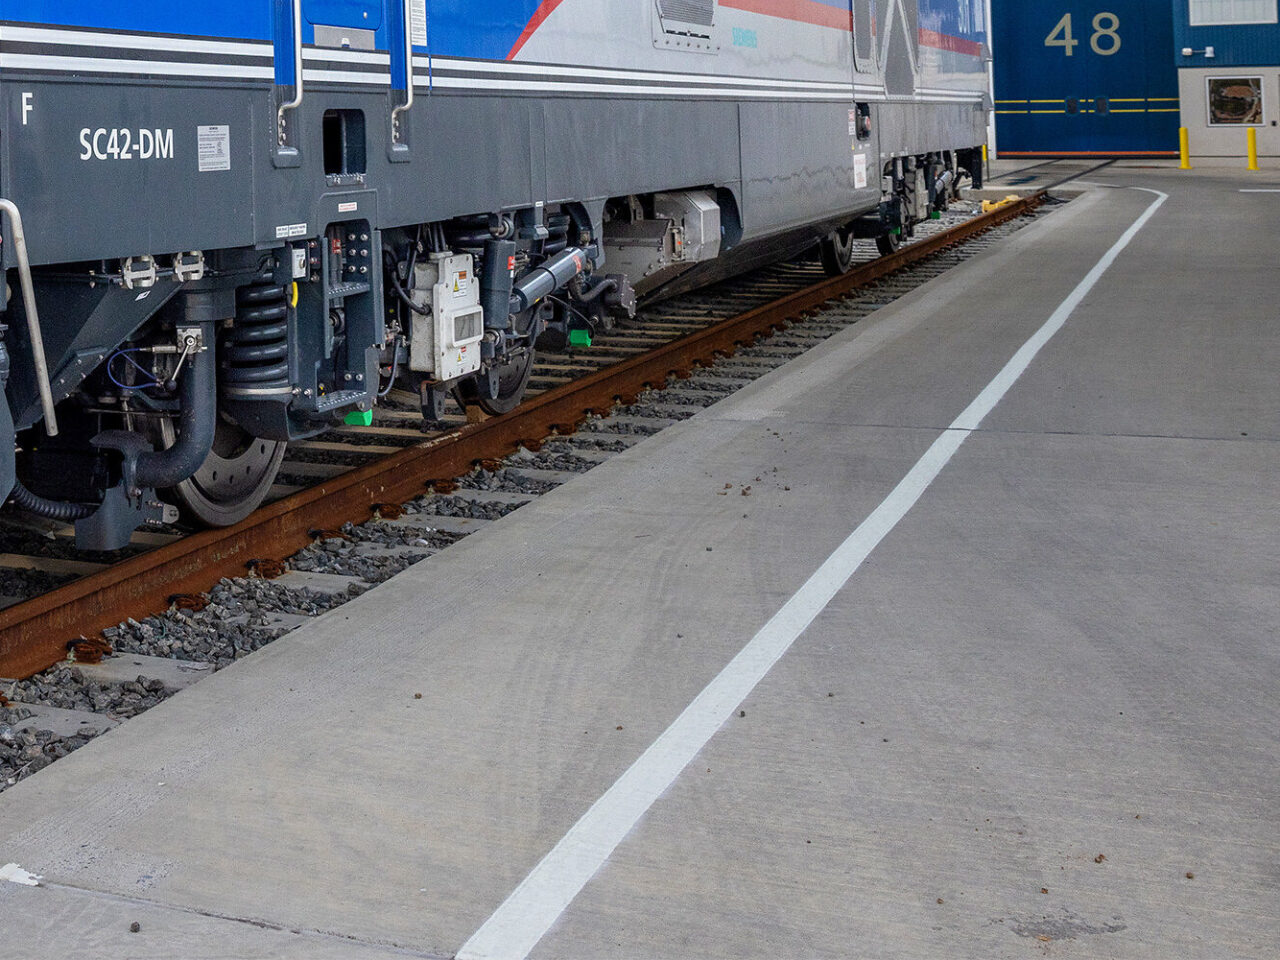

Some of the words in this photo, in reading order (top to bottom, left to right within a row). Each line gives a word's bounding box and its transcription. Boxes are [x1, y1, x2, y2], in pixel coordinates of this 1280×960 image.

[1044, 12, 1122, 57] 48
[21, 91, 34, 126] F
[79, 127, 174, 161] SC42-DM
